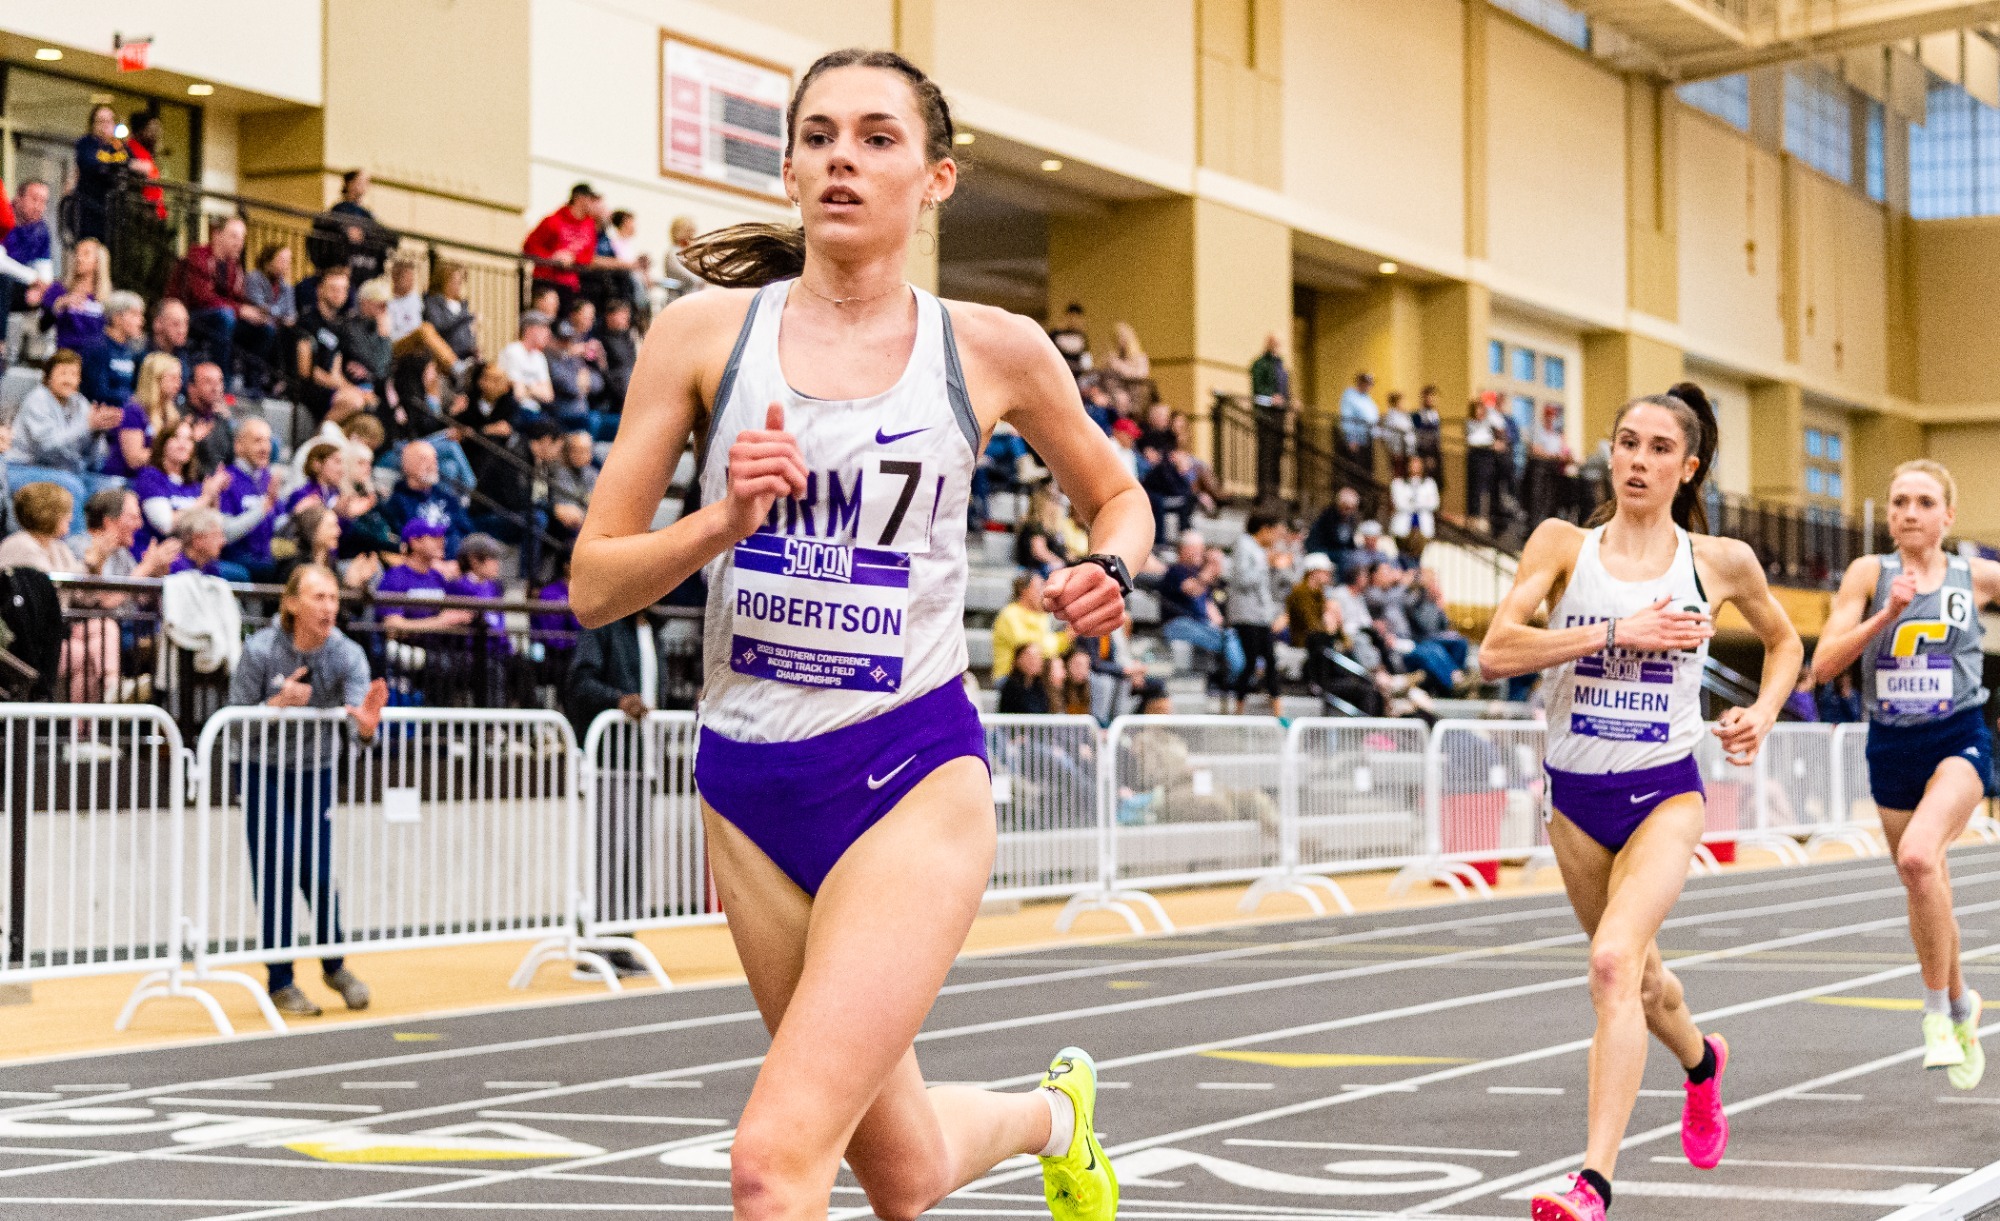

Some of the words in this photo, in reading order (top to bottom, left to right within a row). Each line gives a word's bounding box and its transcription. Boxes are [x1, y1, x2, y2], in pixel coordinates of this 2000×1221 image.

[878, 459, 922, 546] 7
[783, 538, 852, 583] SOCON
[736, 588, 902, 636] ROBERTSON
[1947, 592, 1966, 622] 6
[757, 643, 774, 655] 2023
[775, 647, 816, 662] SOUTHERN
[816, 653, 871, 667] CONFERENCE
[767, 657, 793, 669] INDOOR
[794, 661, 822, 673] TRACK
[832, 666, 856, 676] FIELD
[776, 669, 842, 686] CHAMPIONSHIPS
[1887, 676, 1939, 692] GREEN
[1574, 685, 1669, 712] MULHERN
